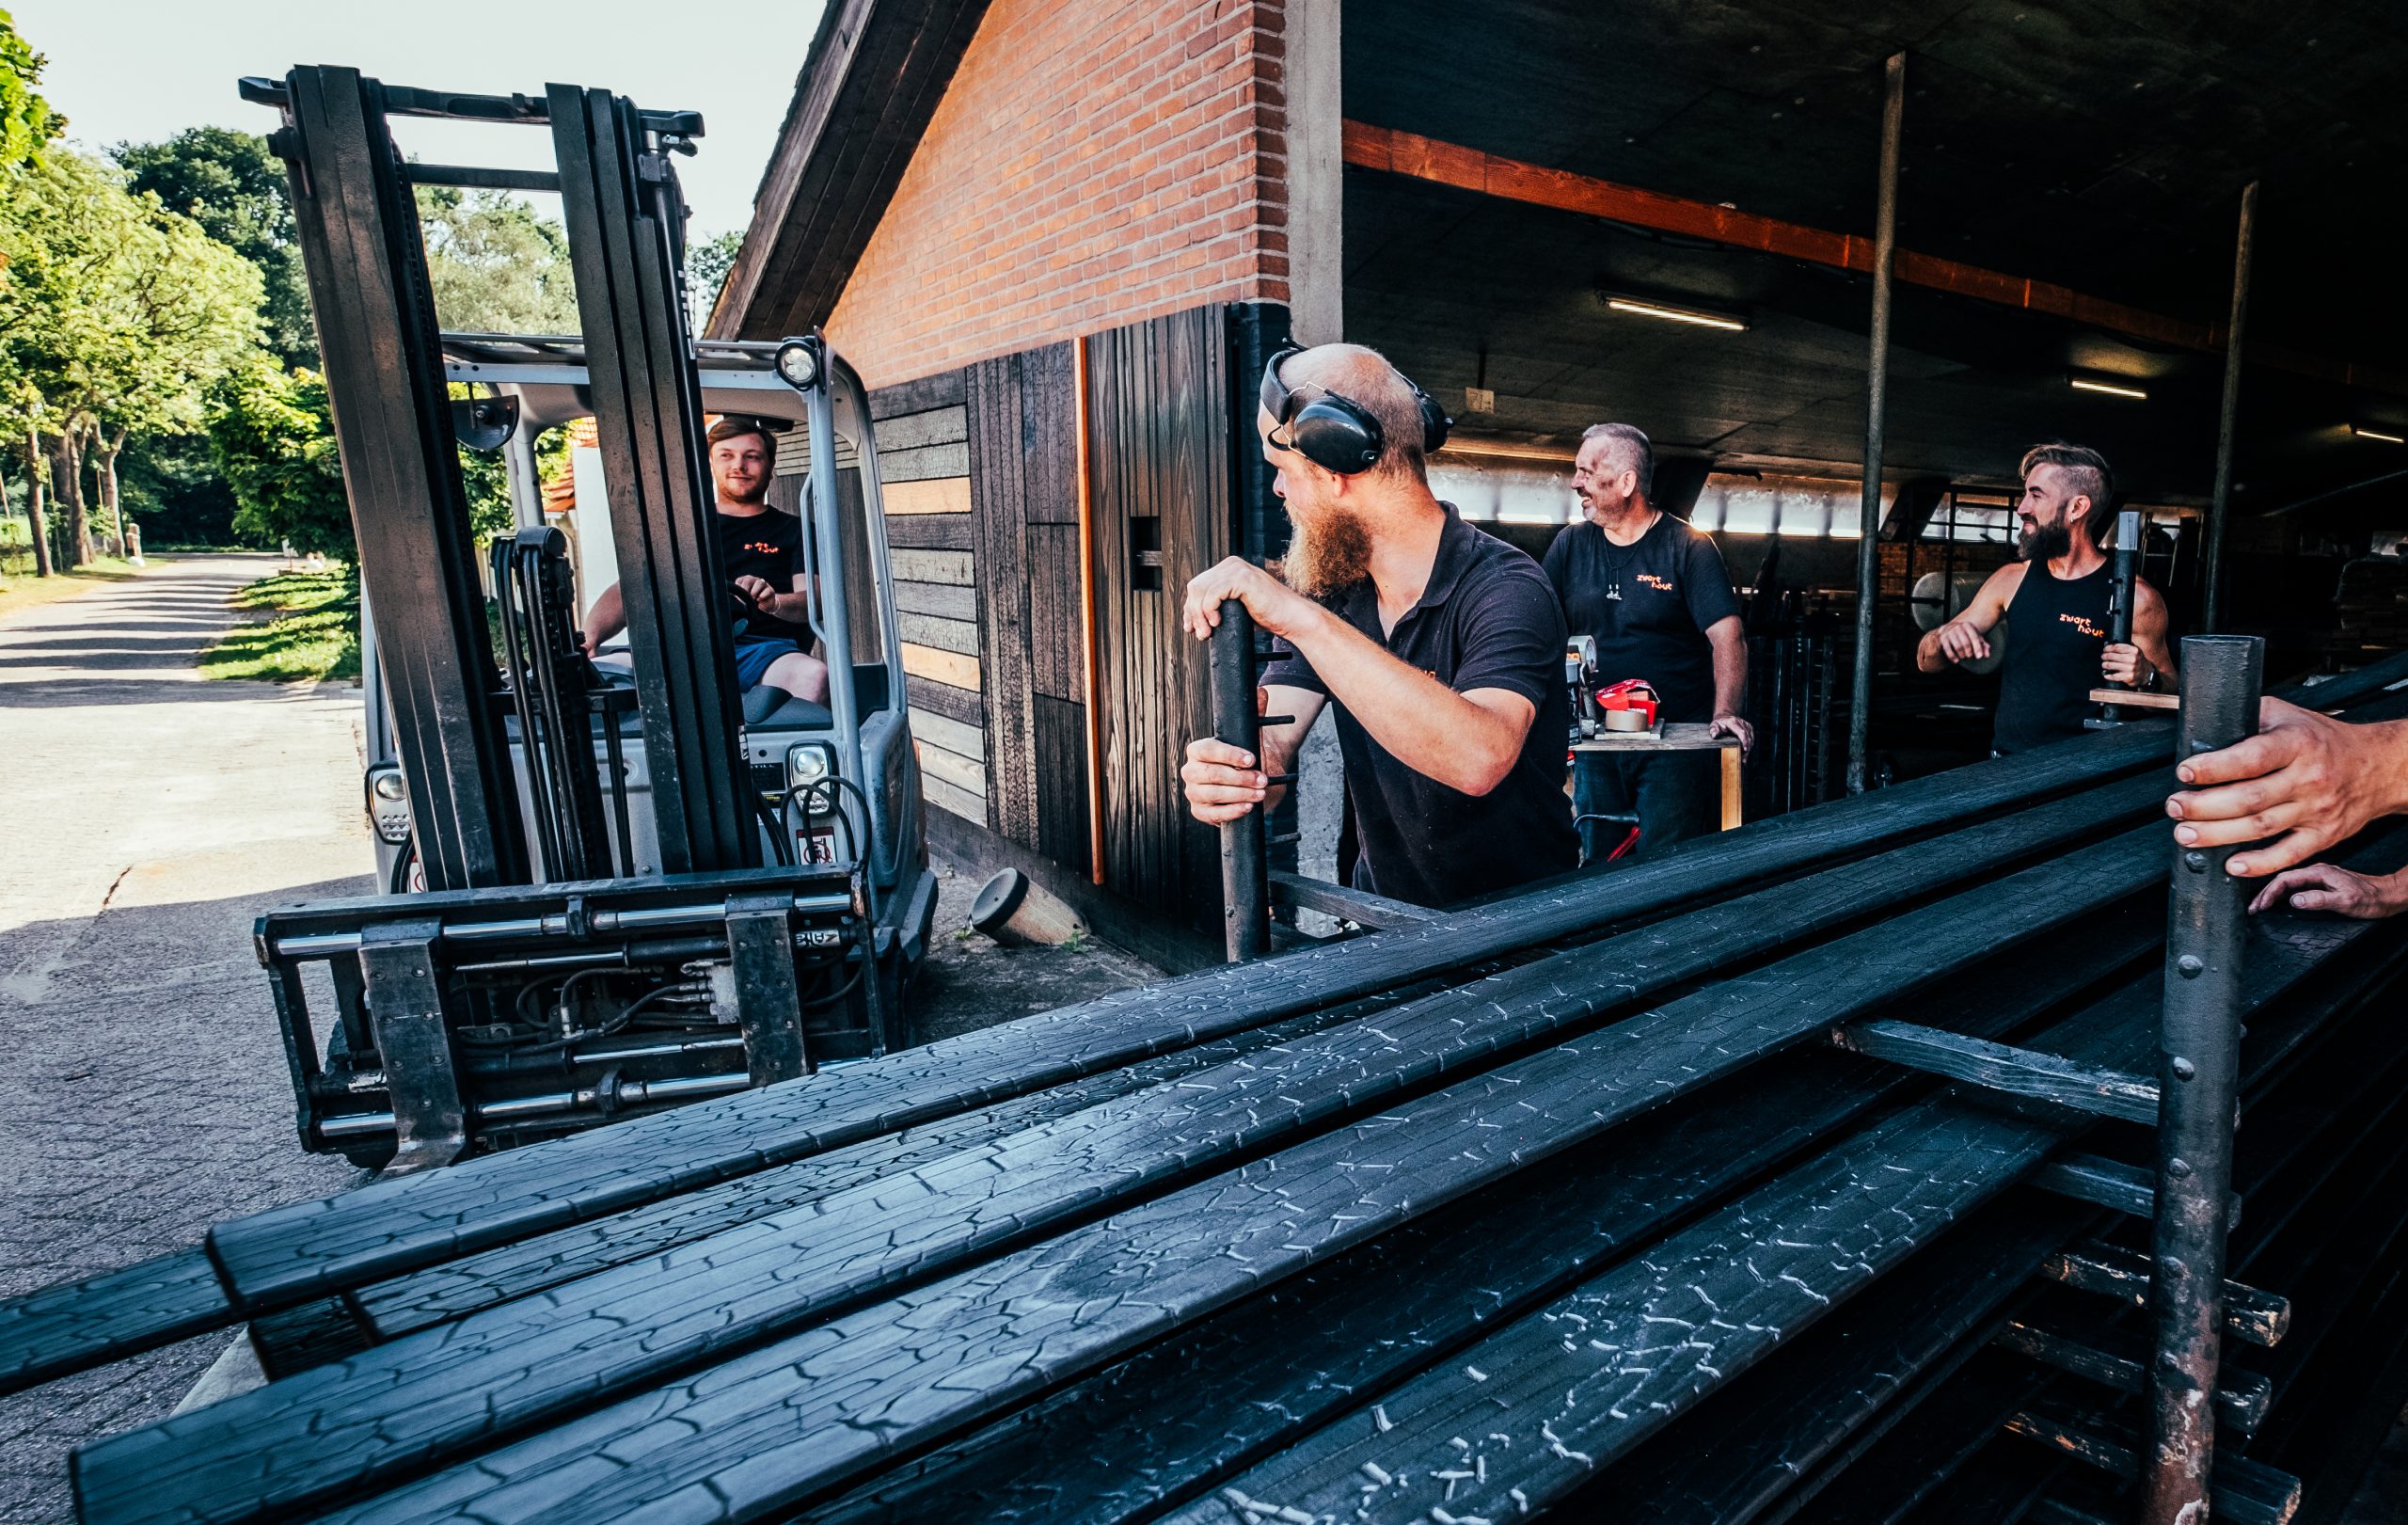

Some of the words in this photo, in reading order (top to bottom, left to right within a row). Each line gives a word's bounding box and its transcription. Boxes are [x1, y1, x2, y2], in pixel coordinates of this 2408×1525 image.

[1637, 574, 1661, 582] zwart
[1651, 581, 1672, 591] hout
[2059, 613, 2091, 627] zwart
[2077, 624, 2104, 638] hout
